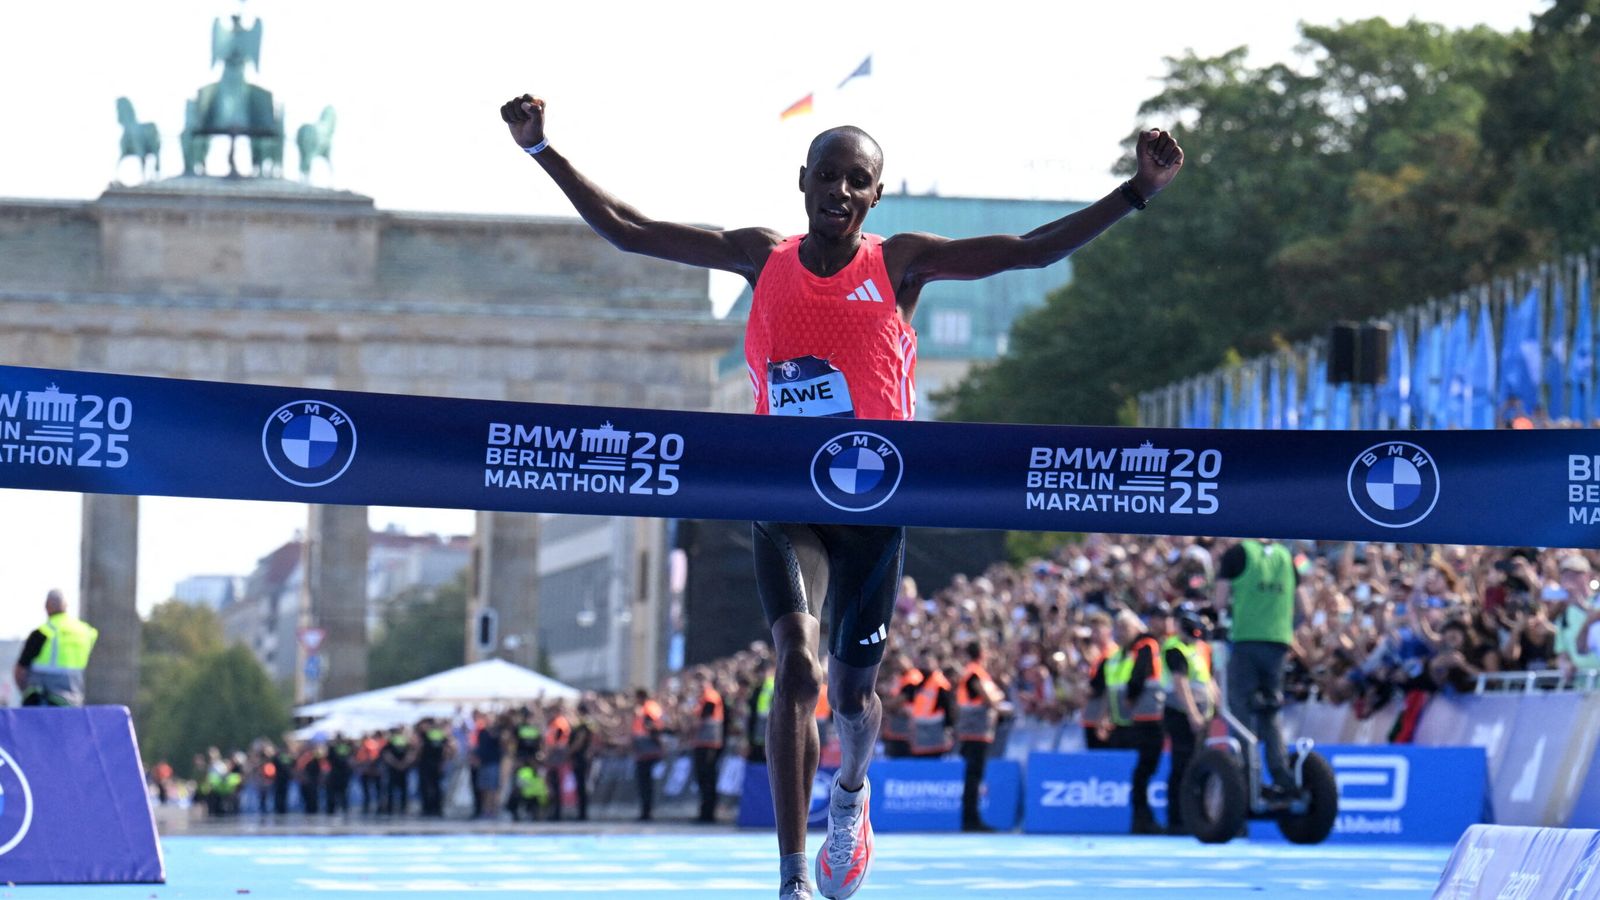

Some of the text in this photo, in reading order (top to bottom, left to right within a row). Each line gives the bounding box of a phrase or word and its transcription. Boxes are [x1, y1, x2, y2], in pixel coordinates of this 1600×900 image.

[79, 395, 133, 431] 20
[277, 403, 346, 427] BMW
[487, 423, 577, 450] BMW
[631, 432, 685, 461] 20
[826, 435, 893, 458] BMW
[0, 444, 73, 466] THON
[77, 433, 129, 468] 25
[485, 447, 575, 469] BERLIN
[1029, 447, 1118, 470] BMW
[1361, 445, 1428, 468] BMW
[1170, 449, 1223, 479] 20
[1568, 454, 1600, 481] B
[484, 469, 625, 494] MARATHON
[628, 463, 680, 496] 25
[1026, 472, 1115, 491] BERLIN
[1026, 492, 1165, 514] MARATHON
[1169, 481, 1219, 515] 25
